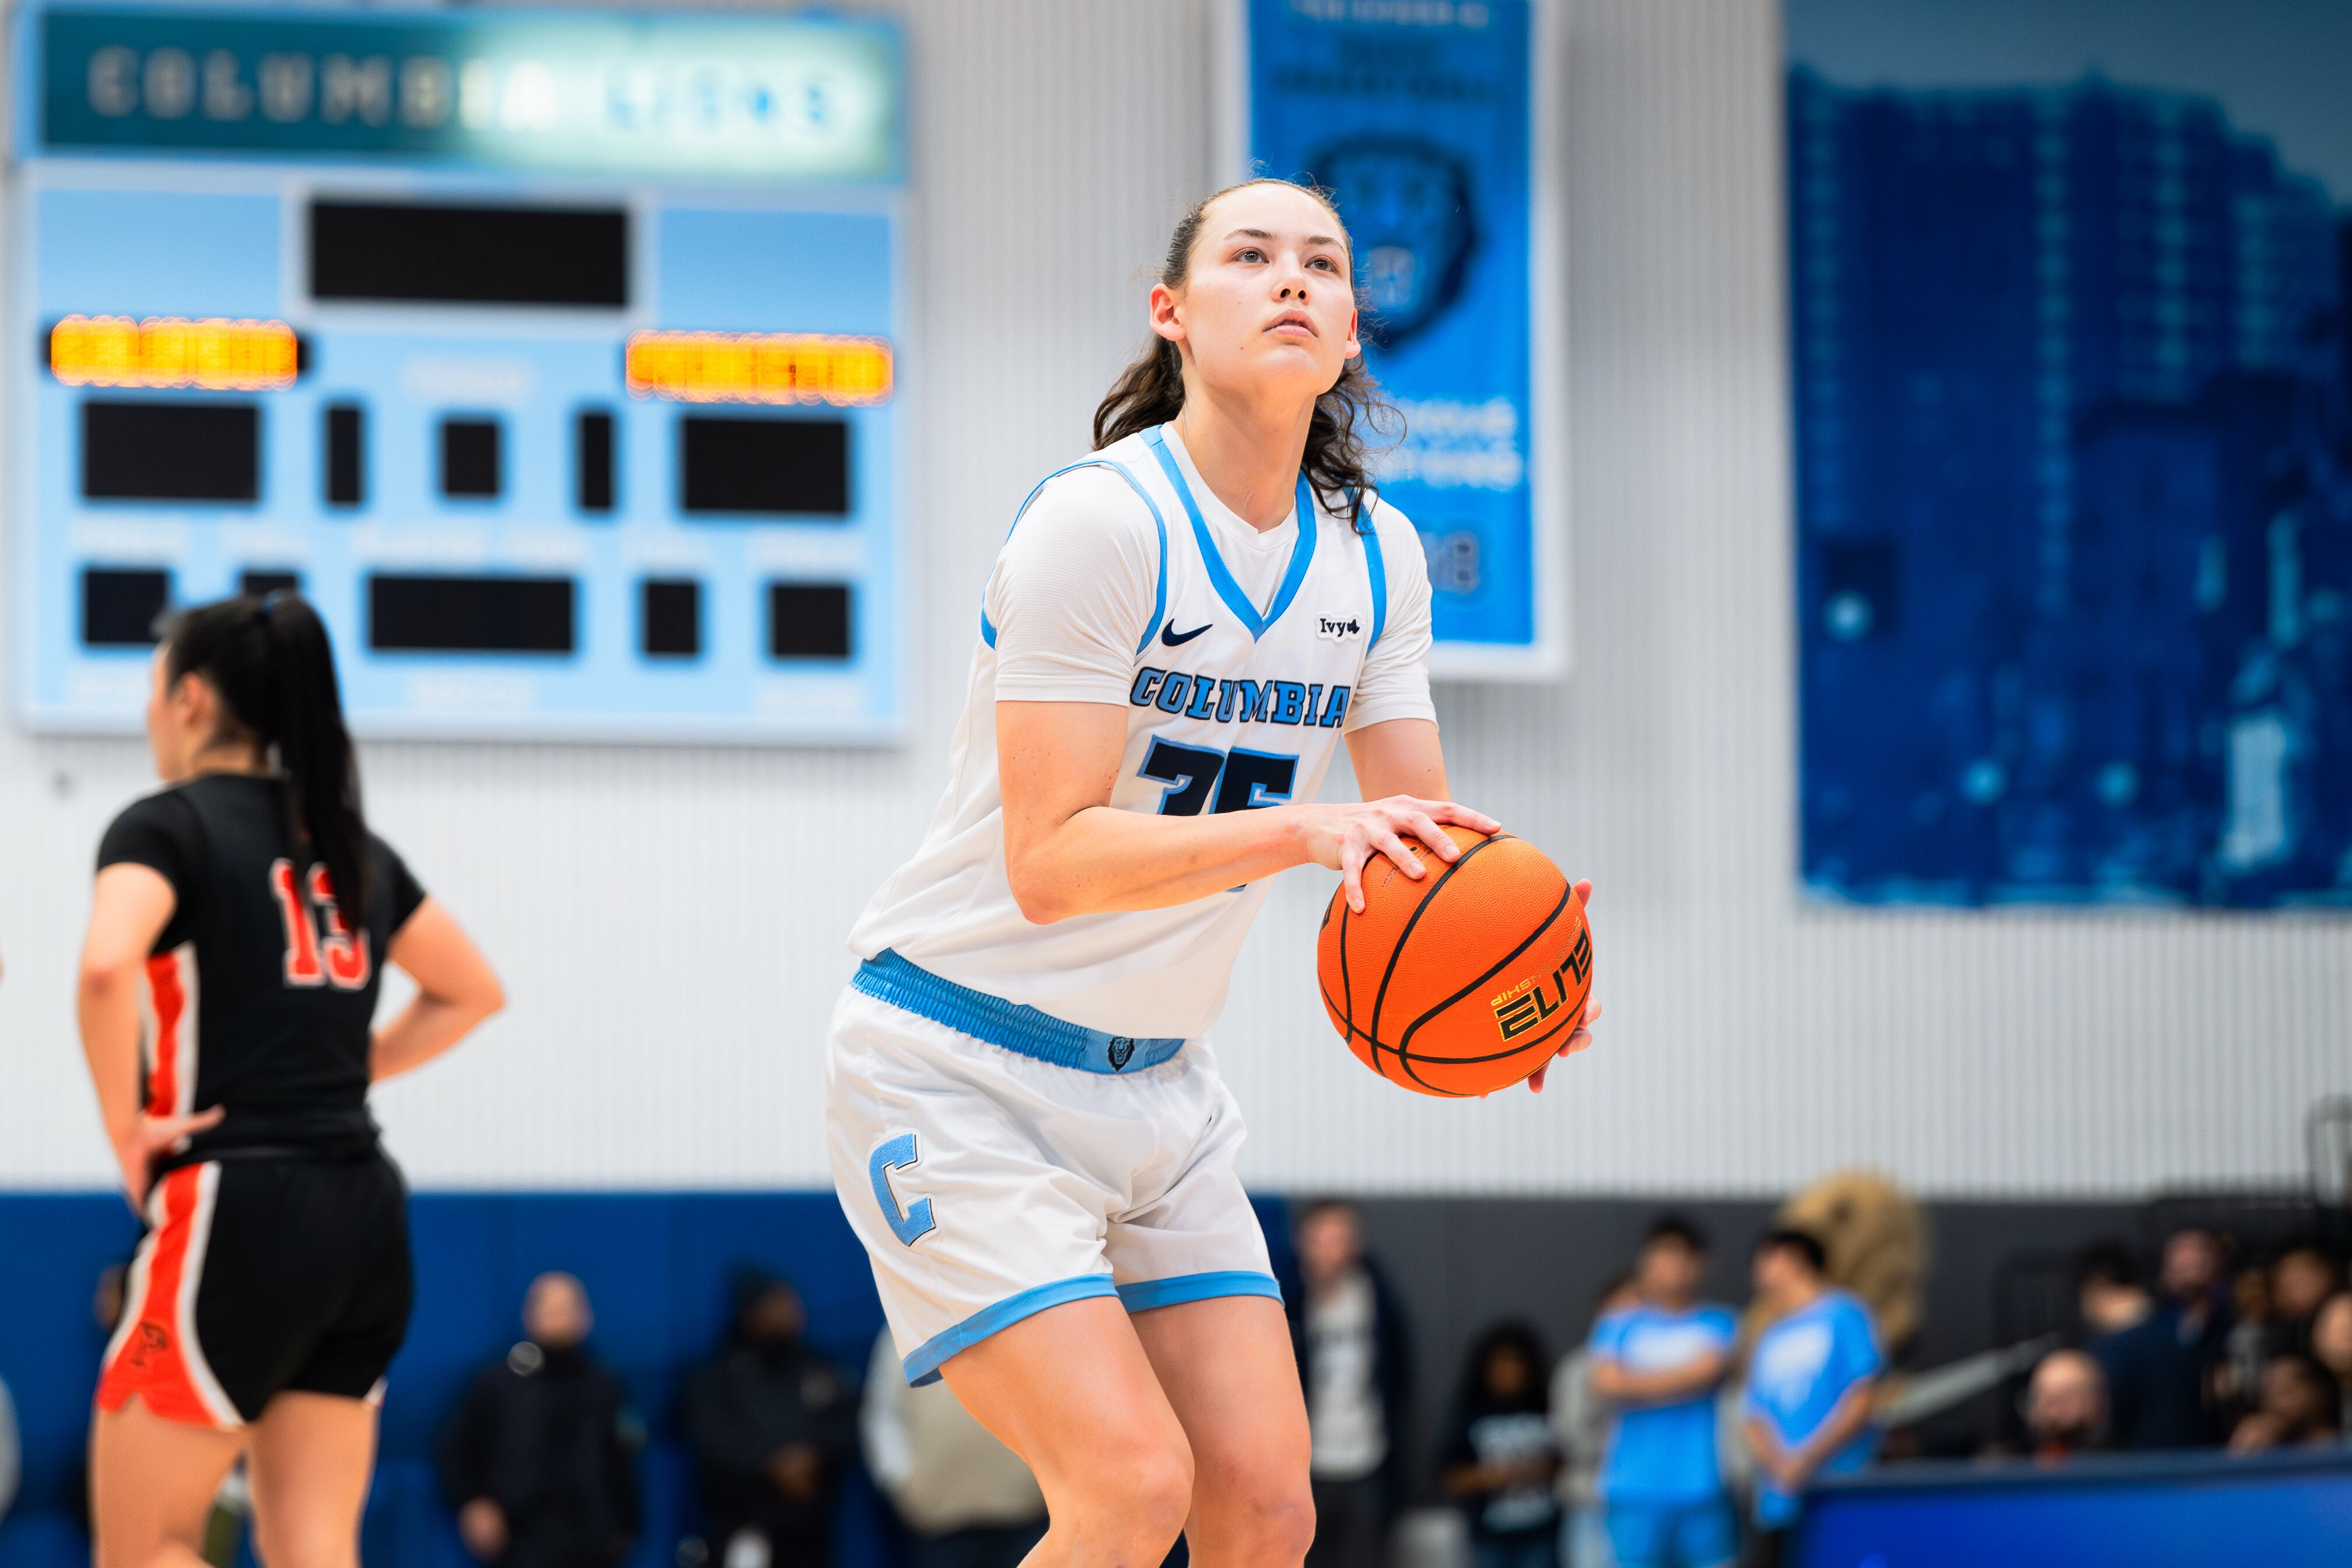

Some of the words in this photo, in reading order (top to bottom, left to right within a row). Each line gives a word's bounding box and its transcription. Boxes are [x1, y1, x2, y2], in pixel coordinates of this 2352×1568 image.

[87, 44, 556, 132] COLUMBIA
[1320, 618, 1346, 637] Ivy
[1130, 666, 1351, 728] COLUMBIA
[269, 858, 372, 990] 13
[1493, 926, 1592, 1042] ELITE
[869, 1132, 937, 1247] C
